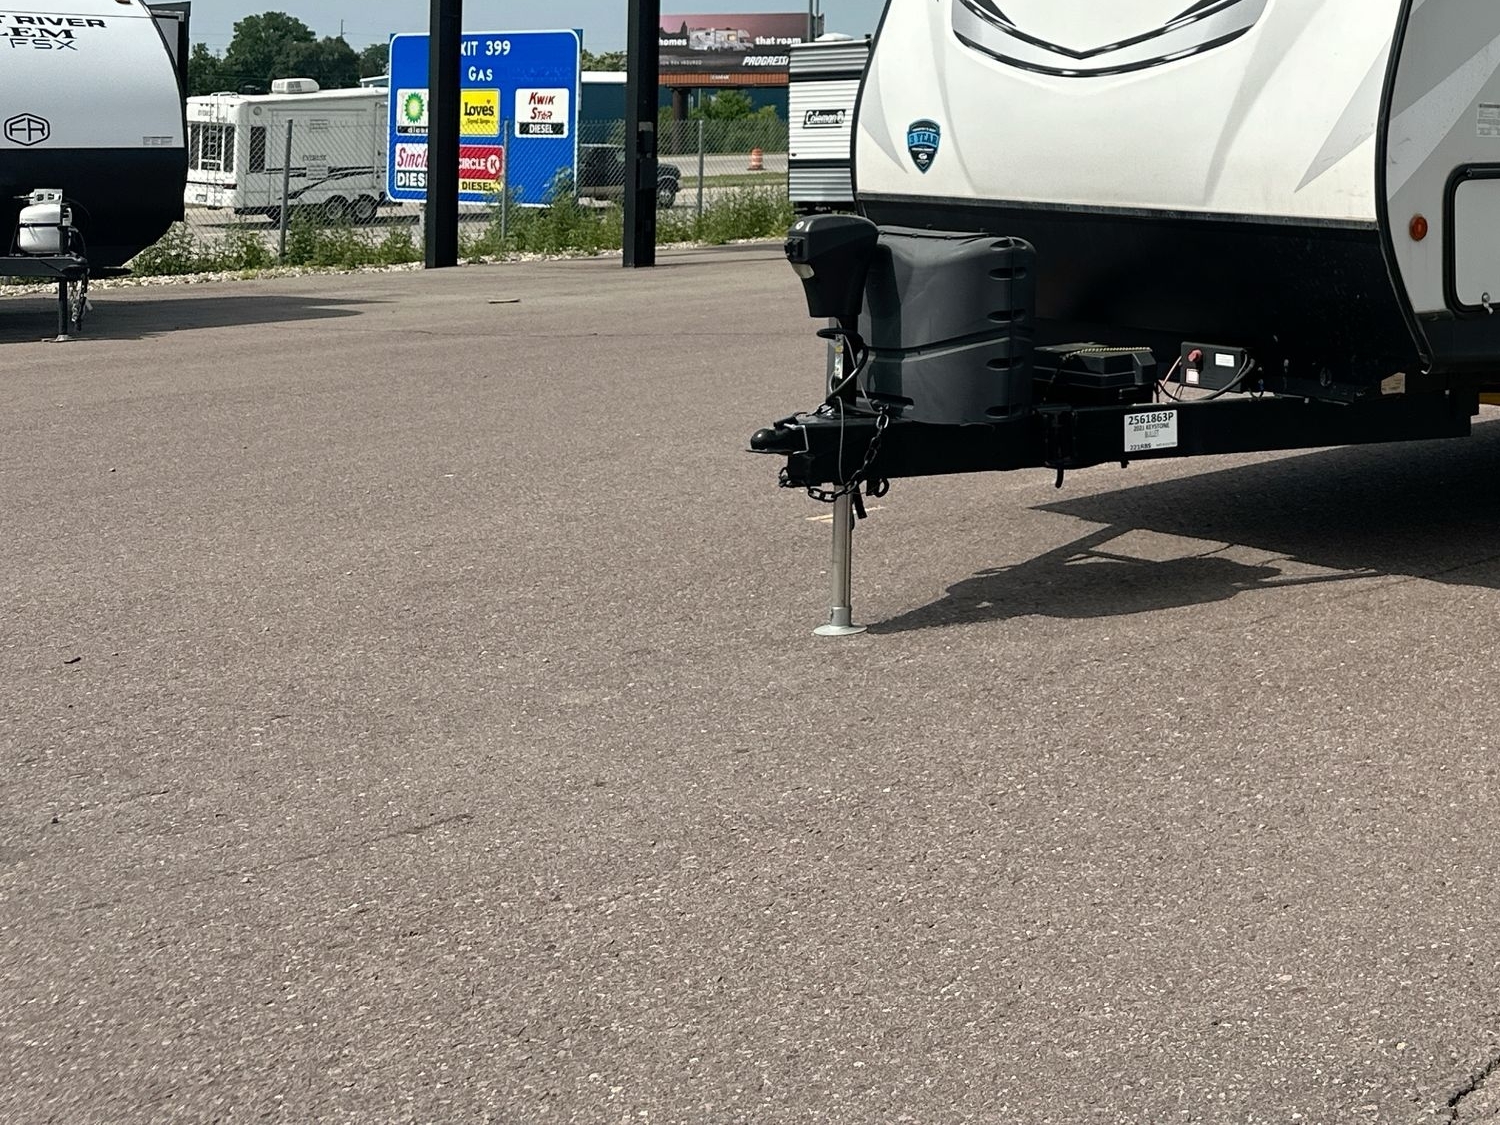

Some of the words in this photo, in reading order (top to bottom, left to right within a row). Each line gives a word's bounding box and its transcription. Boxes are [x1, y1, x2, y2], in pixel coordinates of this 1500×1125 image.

[13, 15, 107, 28] RIVER
[10, 38, 78, 51] FSX
[659, 37, 687, 46] homes
[755, 35, 775, 46] that
[776, 36, 801, 45] roam
[460, 41, 479, 56] XIT
[485, 40, 511, 56] 399
[742, 56, 790, 67] PROGRESSI
[805, 110, 838, 125] Coleman
[529, 123, 554, 134] DIESEL
[397, 147, 428, 168] Sincl
[397, 172, 428, 187] DIES
[1128, 411, 1174, 426] 2561863P
